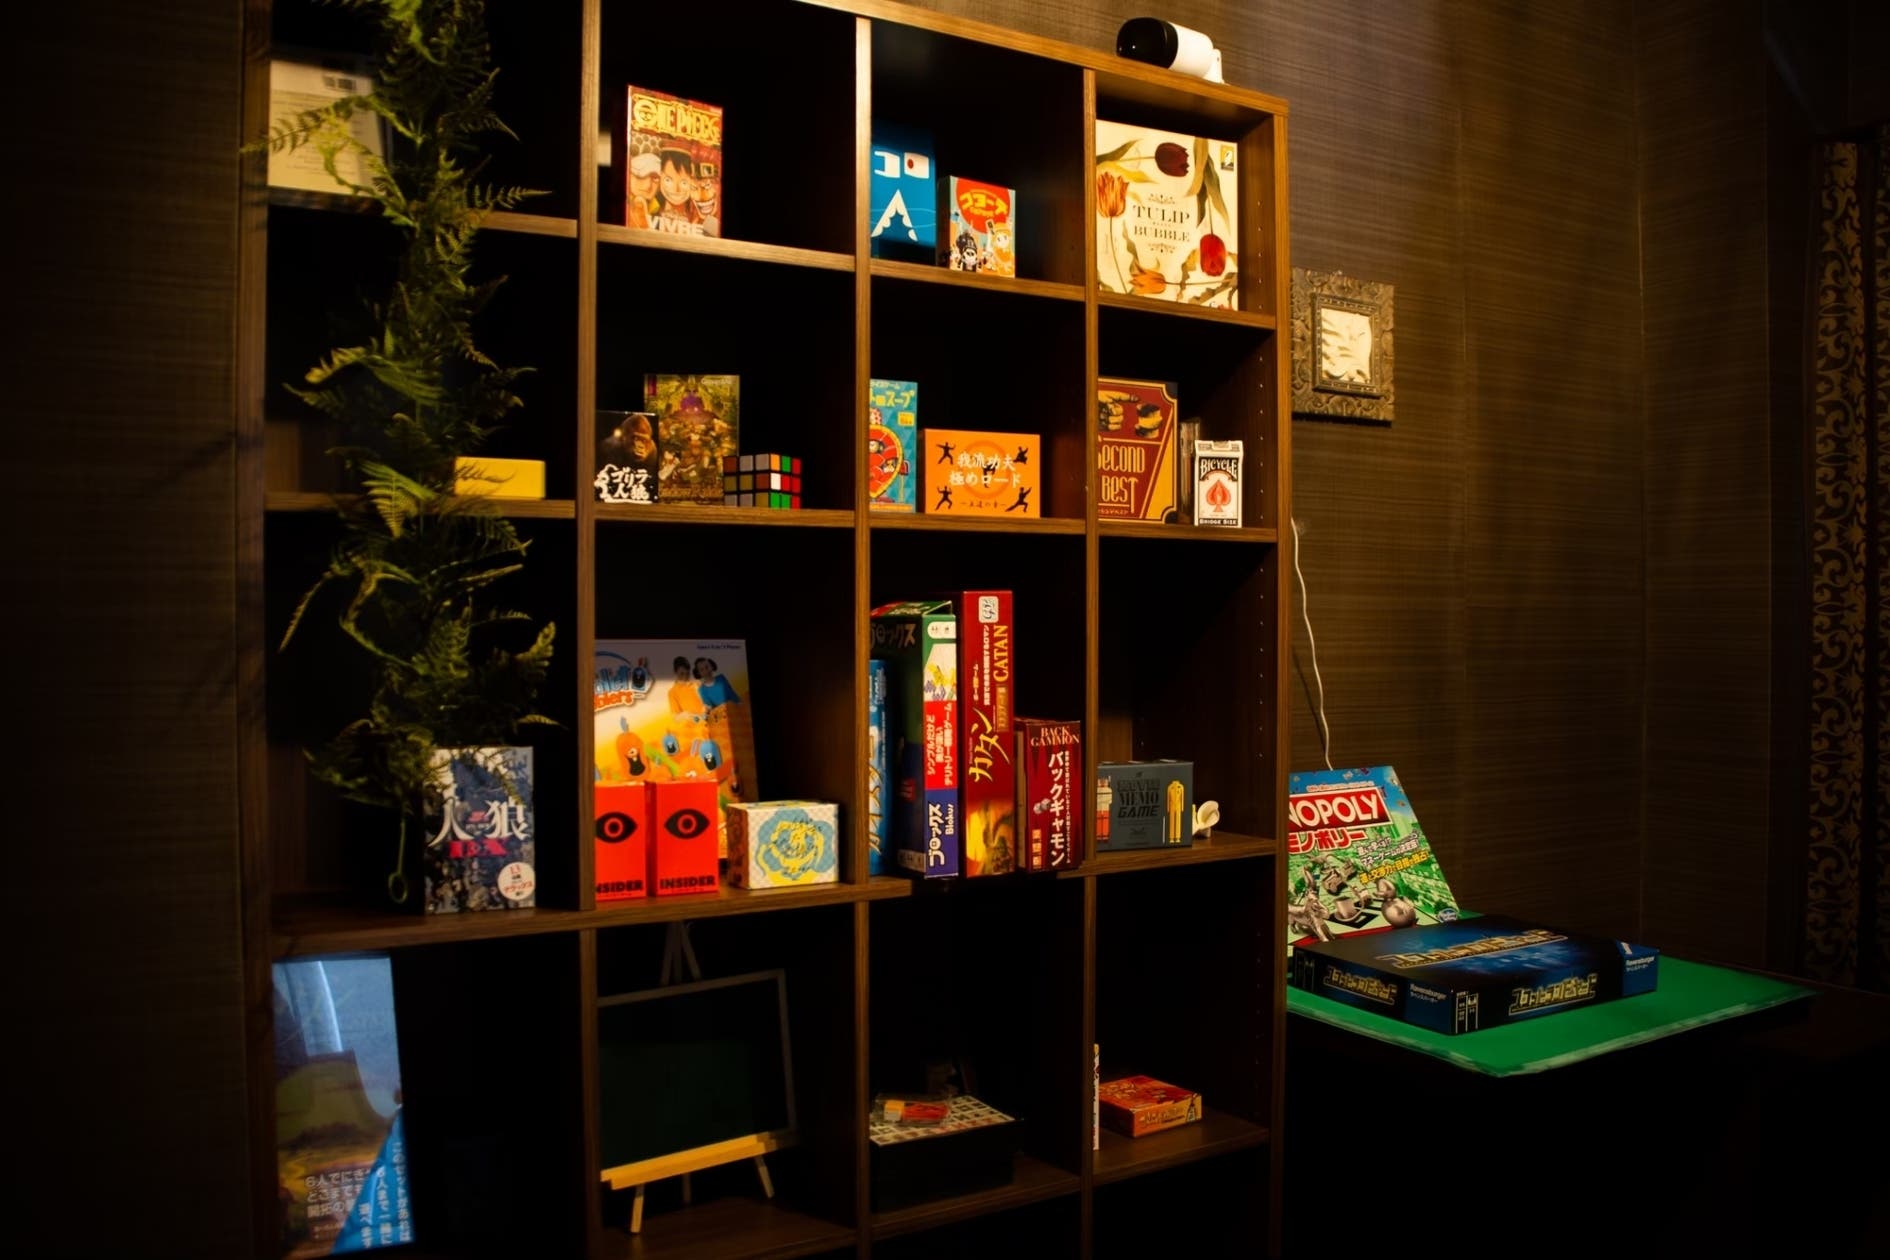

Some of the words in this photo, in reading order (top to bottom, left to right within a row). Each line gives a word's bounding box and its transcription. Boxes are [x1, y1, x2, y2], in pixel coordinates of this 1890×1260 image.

[1132, 204, 1190, 224] TULIP
[1134, 225, 1190, 242] BUBBLE
[1200, 458, 1238, 479] BICYCLE
[993, 624, 1008, 682] CATAN
[1030, 735, 1080, 748] GAMMON
[1041, 726, 1070, 738] BACK
[968, 707, 1010, 782] カタン
[1048, 751, 1065, 867] バックギャモン
[1118, 805, 1160, 819] GAME
[428, 797, 532, 847] 人狼
[929, 803, 945, 868] ブロックス
[660, 876, 715, 889] INSIDER
